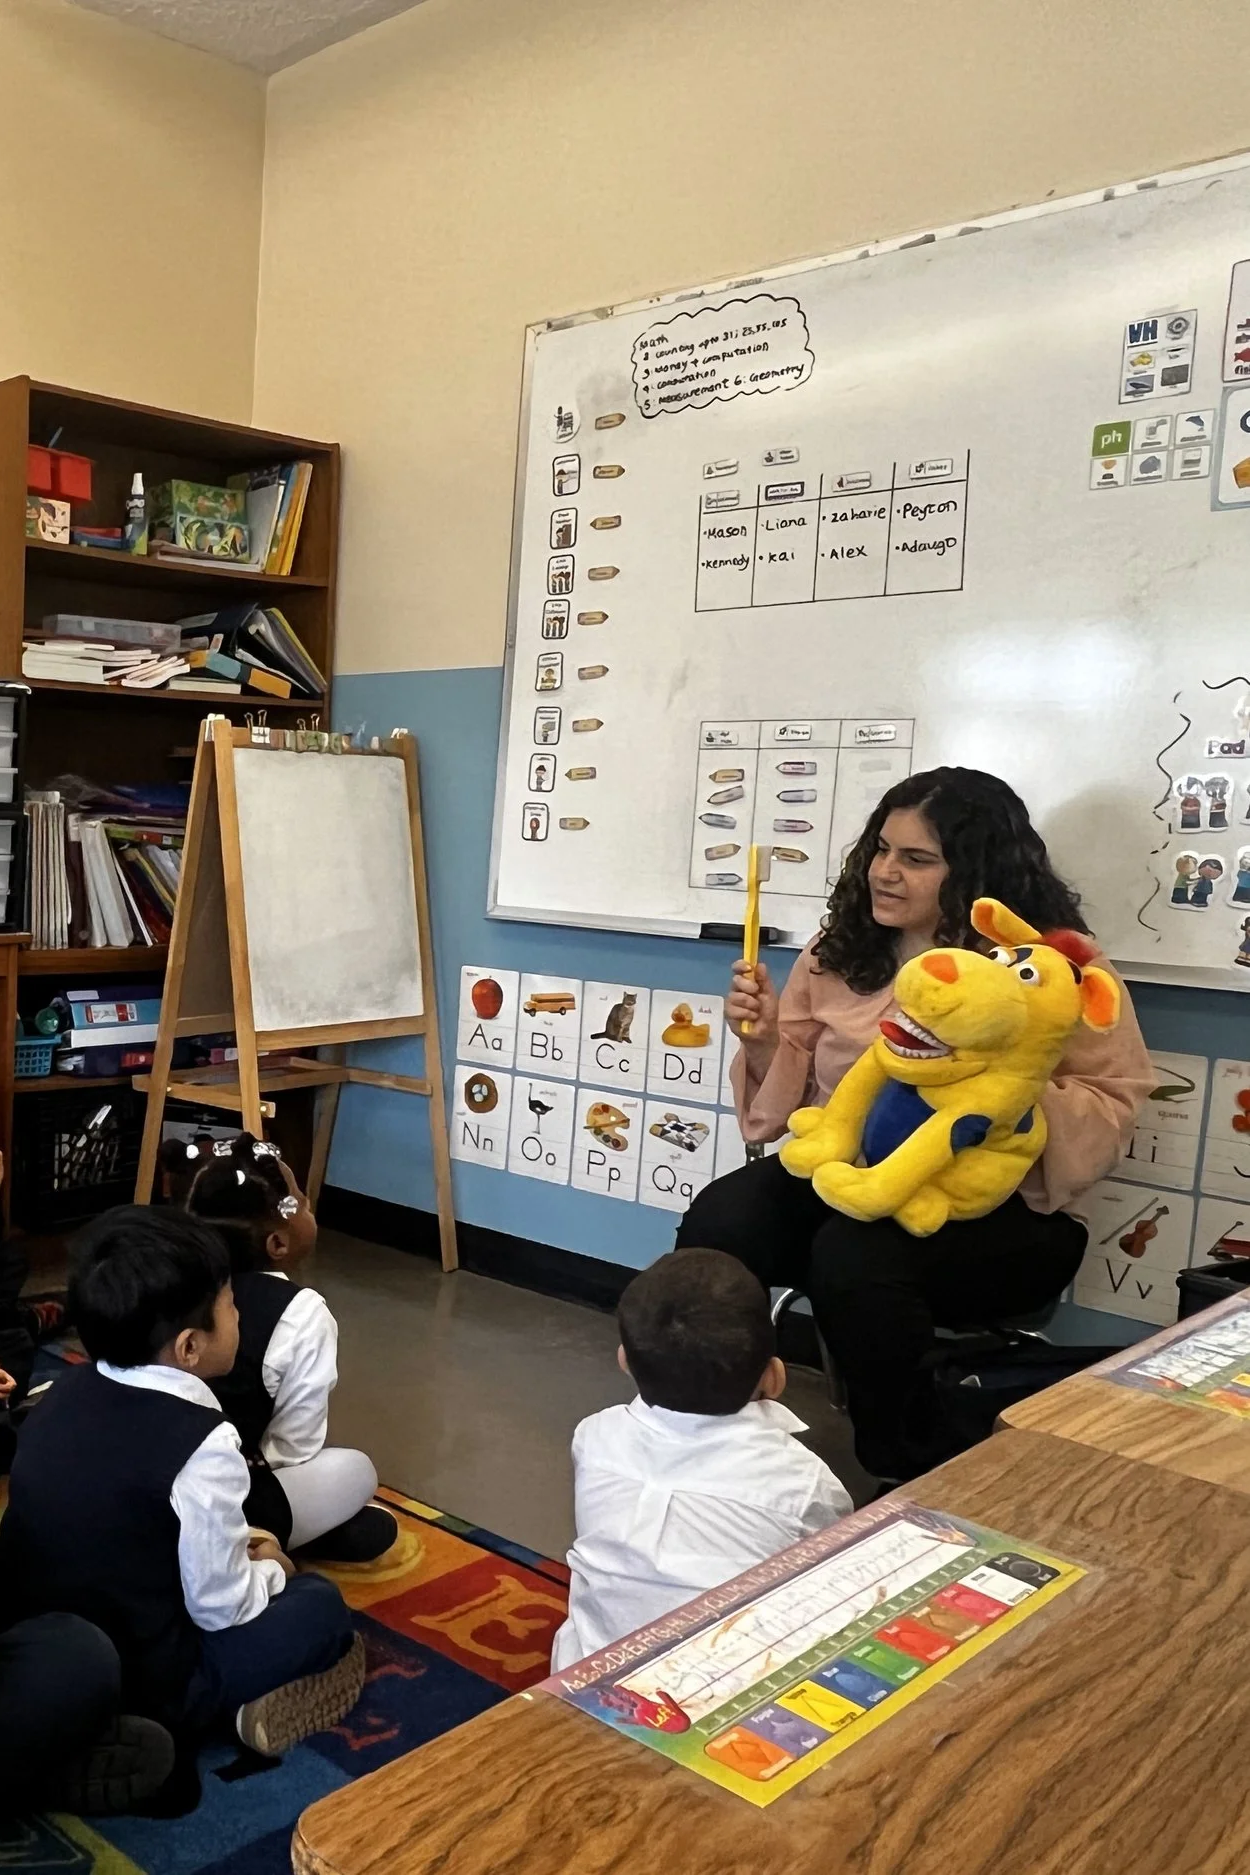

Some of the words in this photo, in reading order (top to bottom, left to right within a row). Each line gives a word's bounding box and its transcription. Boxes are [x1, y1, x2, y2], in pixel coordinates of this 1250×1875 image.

[1128, 319, 1158, 344] WH
[1101, 430, 1122, 449] ph
[707, 524, 748, 540] Mason
[765, 515, 807, 532] Liana
[830, 544, 868, 560] Alex
[468, 1023, 503, 1051] Aa
[530, 1032, 563, 1061] Bb
[595, 1043, 631, 1073] Cc
[663, 1053, 703, 1085] Dd
[462, 1121, 494, 1152] Nn
[521, 1136, 557, 1166] Oo
[586, 1150, 621, 1192] Pp
[652, 1164, 693, 1205] Qq
[1106, 1258, 1153, 1300] Vv
